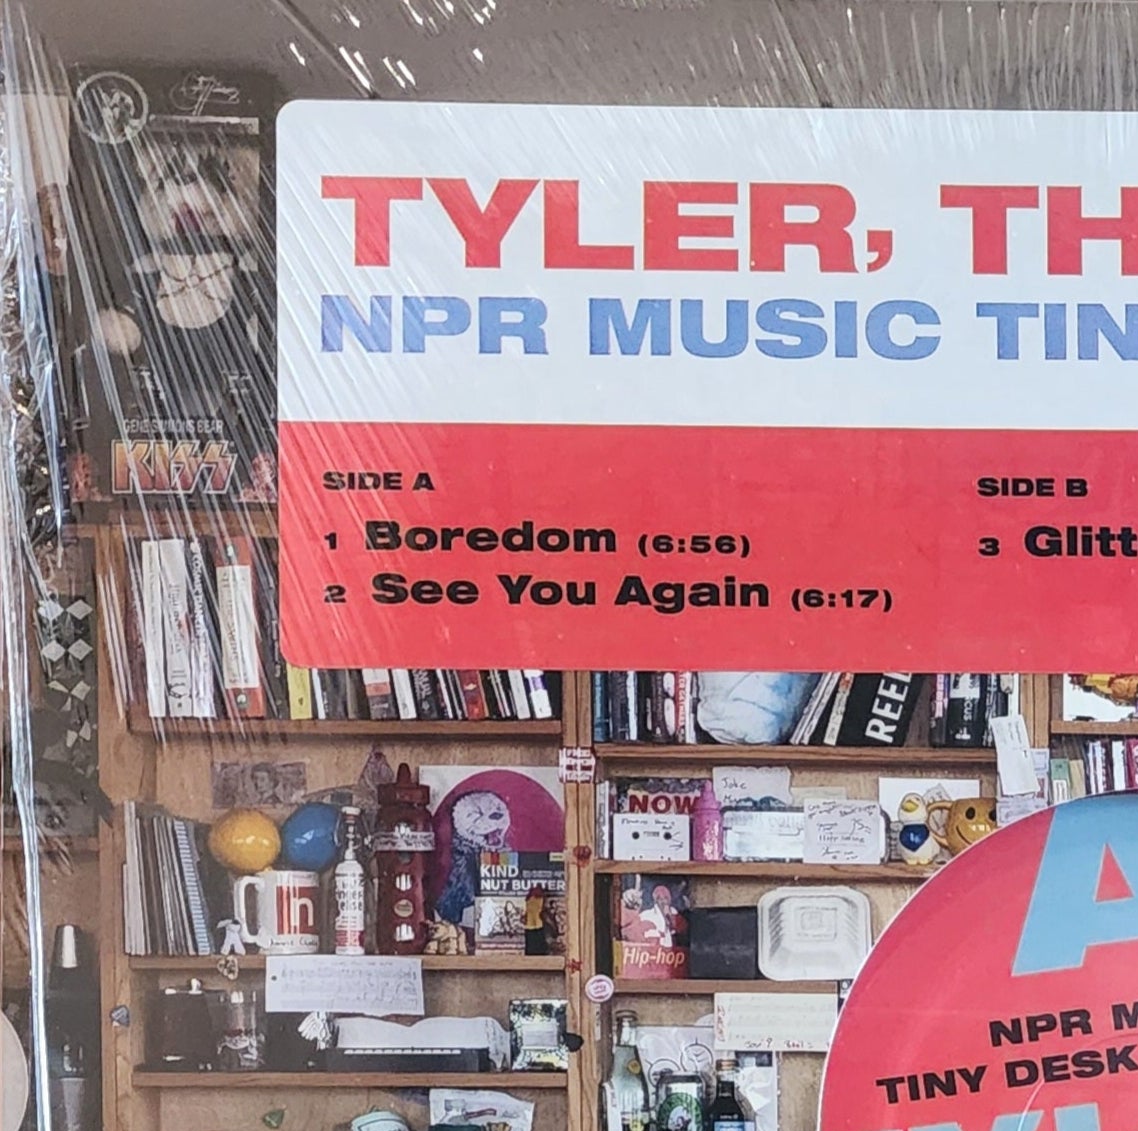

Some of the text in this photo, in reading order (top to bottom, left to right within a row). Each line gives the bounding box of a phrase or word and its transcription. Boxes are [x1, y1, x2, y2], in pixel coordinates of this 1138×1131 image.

[320, 174, 894, 273] TYLER,
[320, 294, 549, 355] NPR
[588, 297, 941, 361] MUSIC
[111, 439, 237, 494] KISS
[322, 471, 436, 492] SIDE A
[976, 477, 1089, 498] SIDE B
[324, 520, 751, 558] 1 Boredom (6:56)
[977, 536, 1001, 556] 3
[323, 574, 893, 614] 2 See You Again (6:17)
[628, 794, 702, 815] NOW
[480, 864, 519, 878] KIND
[480, 879, 509, 890] NUT
[622, 947, 686, 969] Hip-hop
[989, 1008, 1093, 1047] NPR
[876, 1064, 988, 1104] TINY
